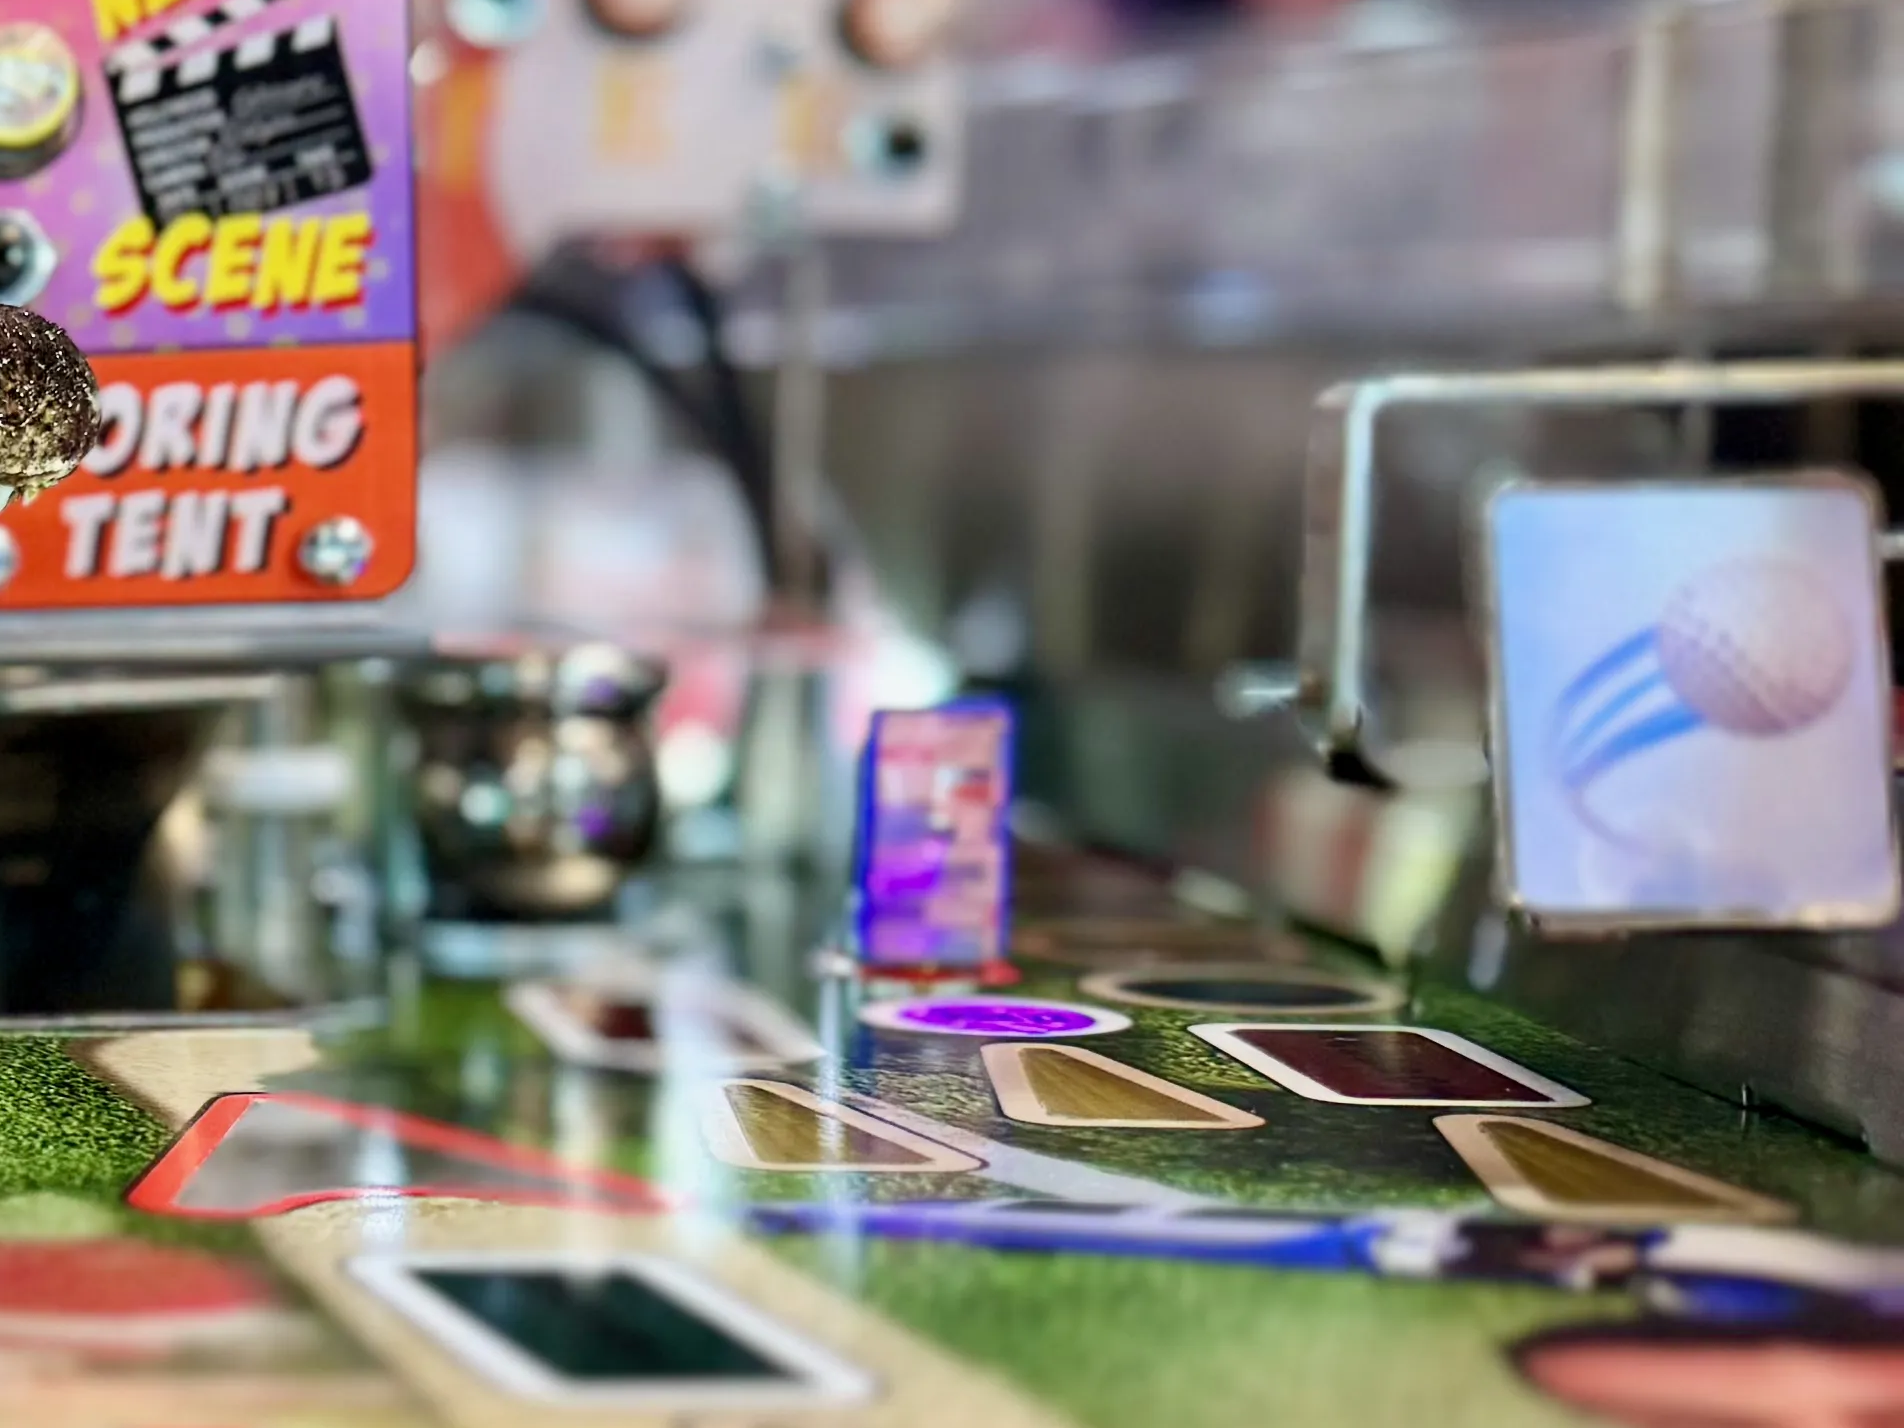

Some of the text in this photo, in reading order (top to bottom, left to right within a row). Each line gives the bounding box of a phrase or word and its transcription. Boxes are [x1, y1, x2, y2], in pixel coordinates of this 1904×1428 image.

[91, 212, 376, 320] SCENE
[80, 375, 365, 479] ORING
[60, 488, 294, 583] TENT
